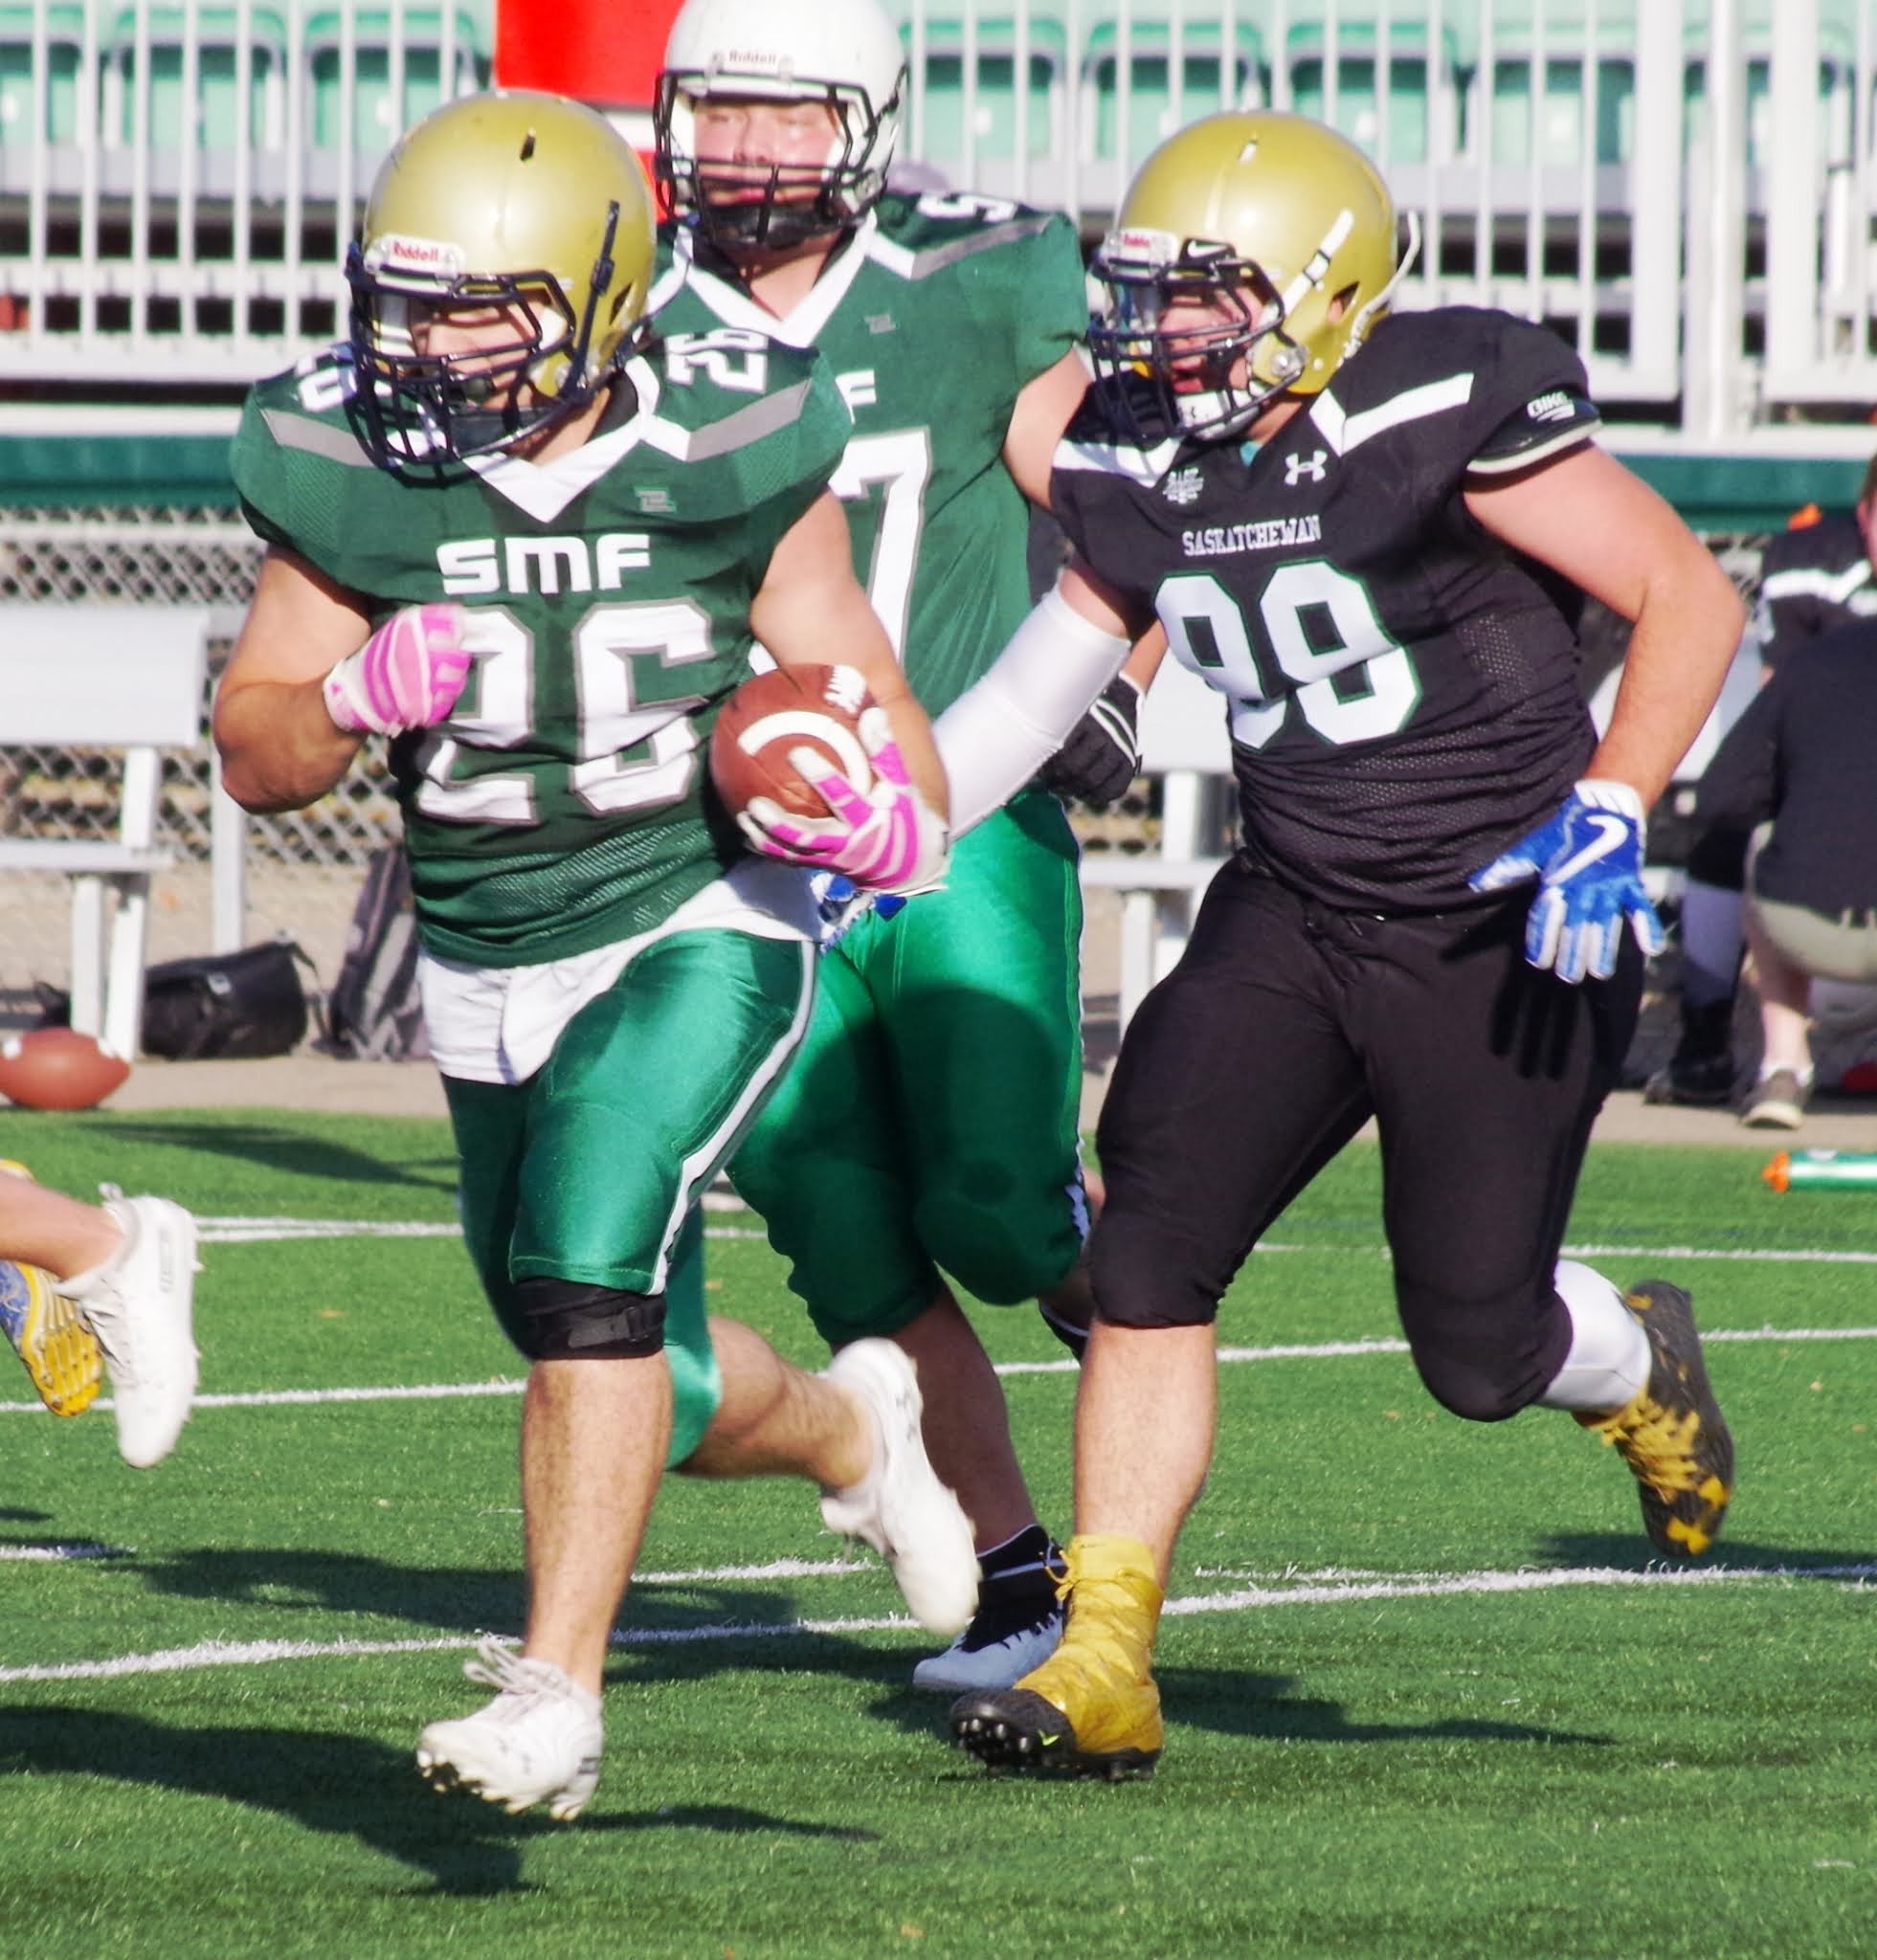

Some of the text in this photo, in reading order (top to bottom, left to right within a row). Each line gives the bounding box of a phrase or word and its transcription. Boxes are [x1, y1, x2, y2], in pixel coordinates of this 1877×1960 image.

[436, 533, 651, 595] SMF
[1181, 514, 1323, 557] SASKATCHEWAN
[416, 597, 718, 827] 26
